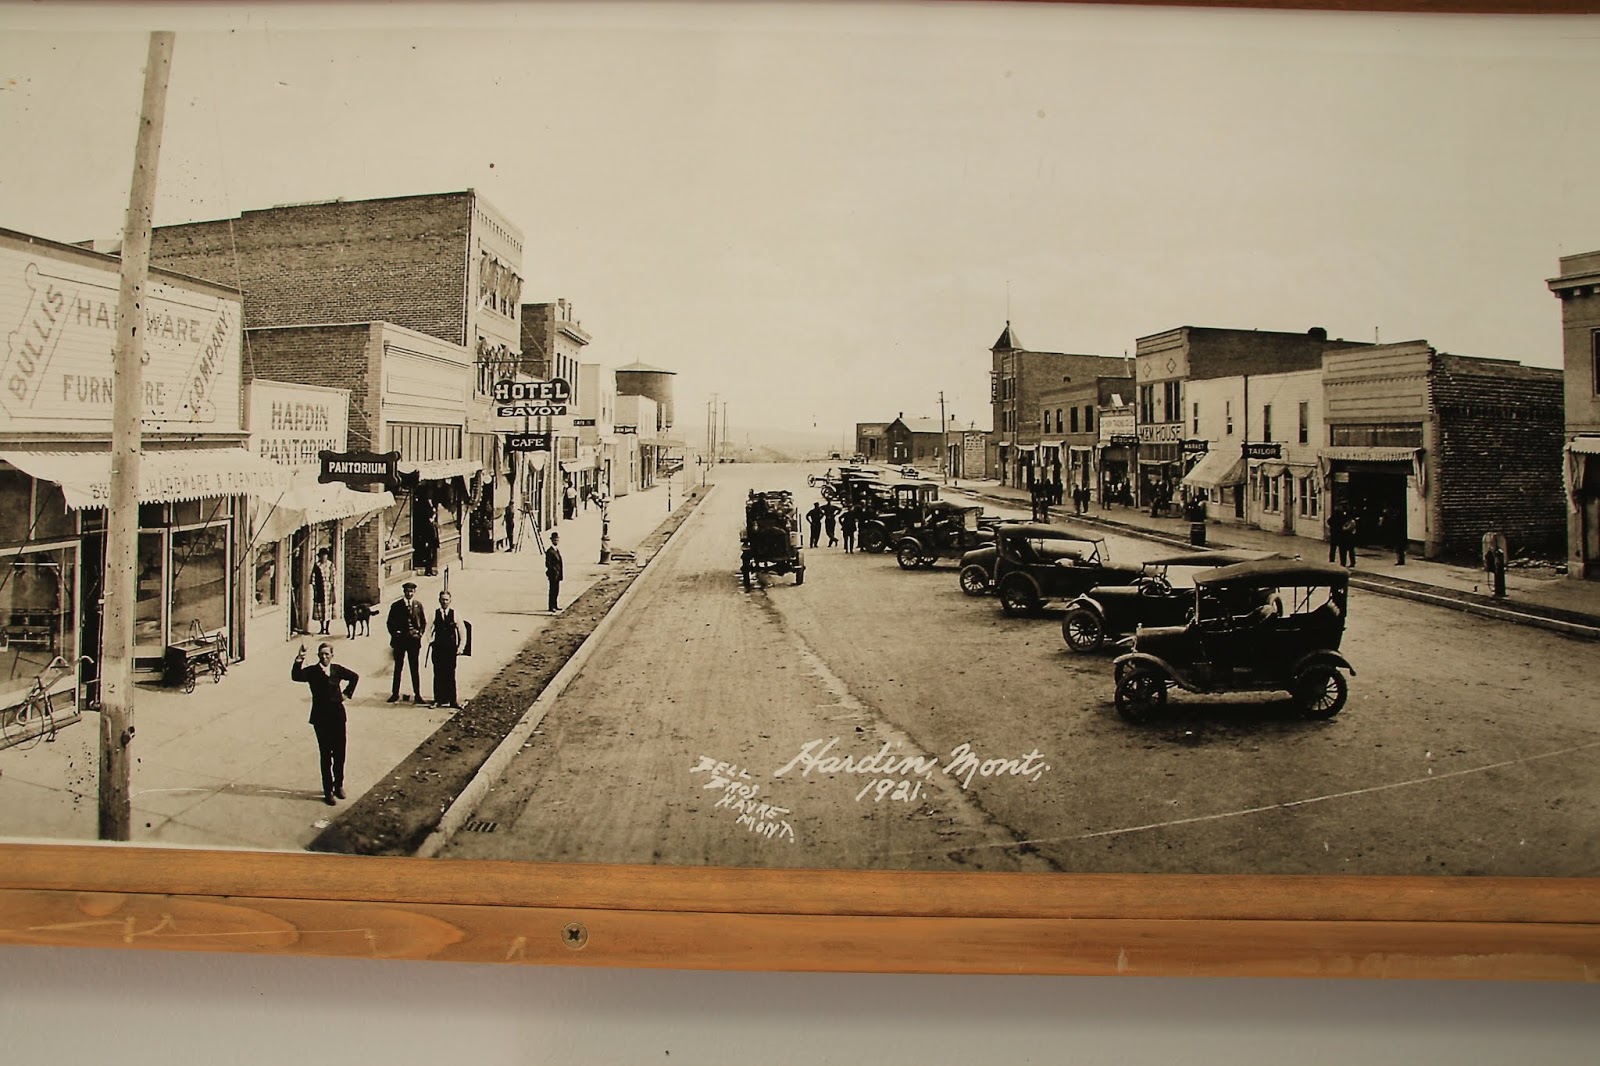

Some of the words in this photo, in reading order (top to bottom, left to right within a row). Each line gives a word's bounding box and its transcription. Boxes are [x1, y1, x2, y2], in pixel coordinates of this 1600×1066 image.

[77, 298, 200, 343] HAWARE
[8, 284, 64, 401] BULLIS
[189, 310, 229, 412] COMPANY
[63, 374, 165, 405] FURNRE
[495, 382, 569, 400] HOTEL
[271, 400, 330, 431] HARDIN
[501, 406, 564, 417] SAVOY
[511, 437, 545, 447] CAFE
[1156, 425, 1181, 441] HOUSE
[1249, 447, 1277, 455] TAILOR
[328, 461, 387, 474] PANTORIUM
[689, 755, 752, 780] BELL
[773, 737, 939, 780] Hardin,
[855, 778, 928, 803] 1921.
[714, 793, 790, 820] HAVRE
